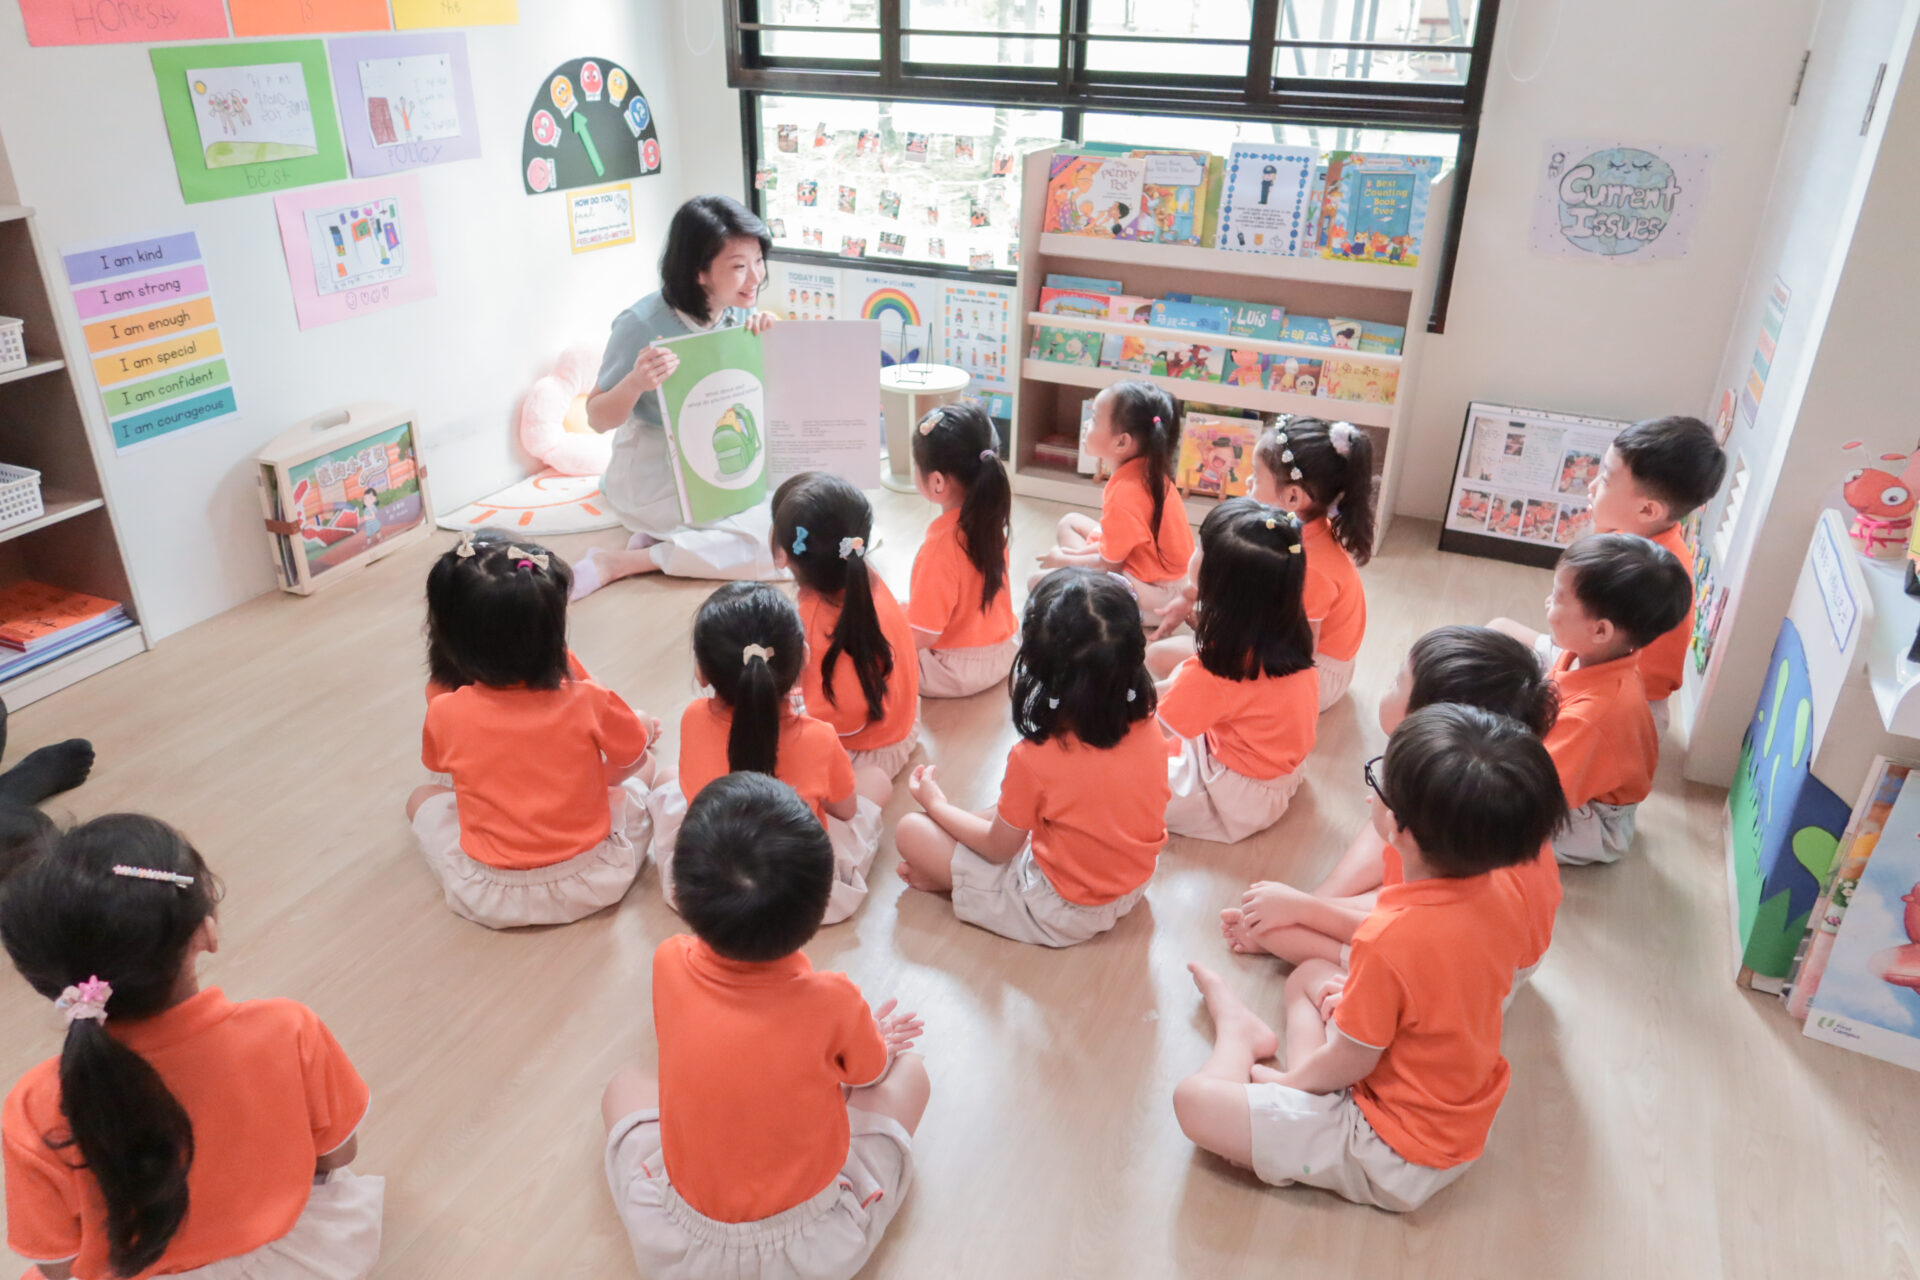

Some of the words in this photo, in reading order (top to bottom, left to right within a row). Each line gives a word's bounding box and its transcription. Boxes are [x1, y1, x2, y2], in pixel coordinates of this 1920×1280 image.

[243, 166, 292, 190] best
[1376, 179, 1397, 188] Best
[1558, 164, 1682, 213] Current
[600, 194, 613, 203] YOU
[1363, 188, 1409, 198] Counting
[1373, 197, 1396, 207] Book
[1373, 206, 1394, 215] Ever
[1559, 206, 1663, 241] Issues
[100, 255, 109, 270] I
[114, 256, 134, 268] am
[136, 246, 163, 263] kind
[788, 271, 813, 282] TODAY
[819, 275, 836, 285] FEEL
[100, 289, 109, 304] I
[114, 290, 135, 302] am
[138, 279, 181, 297] strong
[109, 324, 119, 339] I
[123, 324, 145, 337] am
[147, 309, 191, 330] enough
[119, 358, 129, 372] I
[133, 356, 153, 370] am
[156, 340, 197, 364] special
[121, 391, 131, 406] I
[135, 389, 155, 402] am
[158, 368, 214, 395] confident
[122, 424, 131, 439] I
[134, 421, 154, 435] am
[157, 400, 224, 428] courageous
